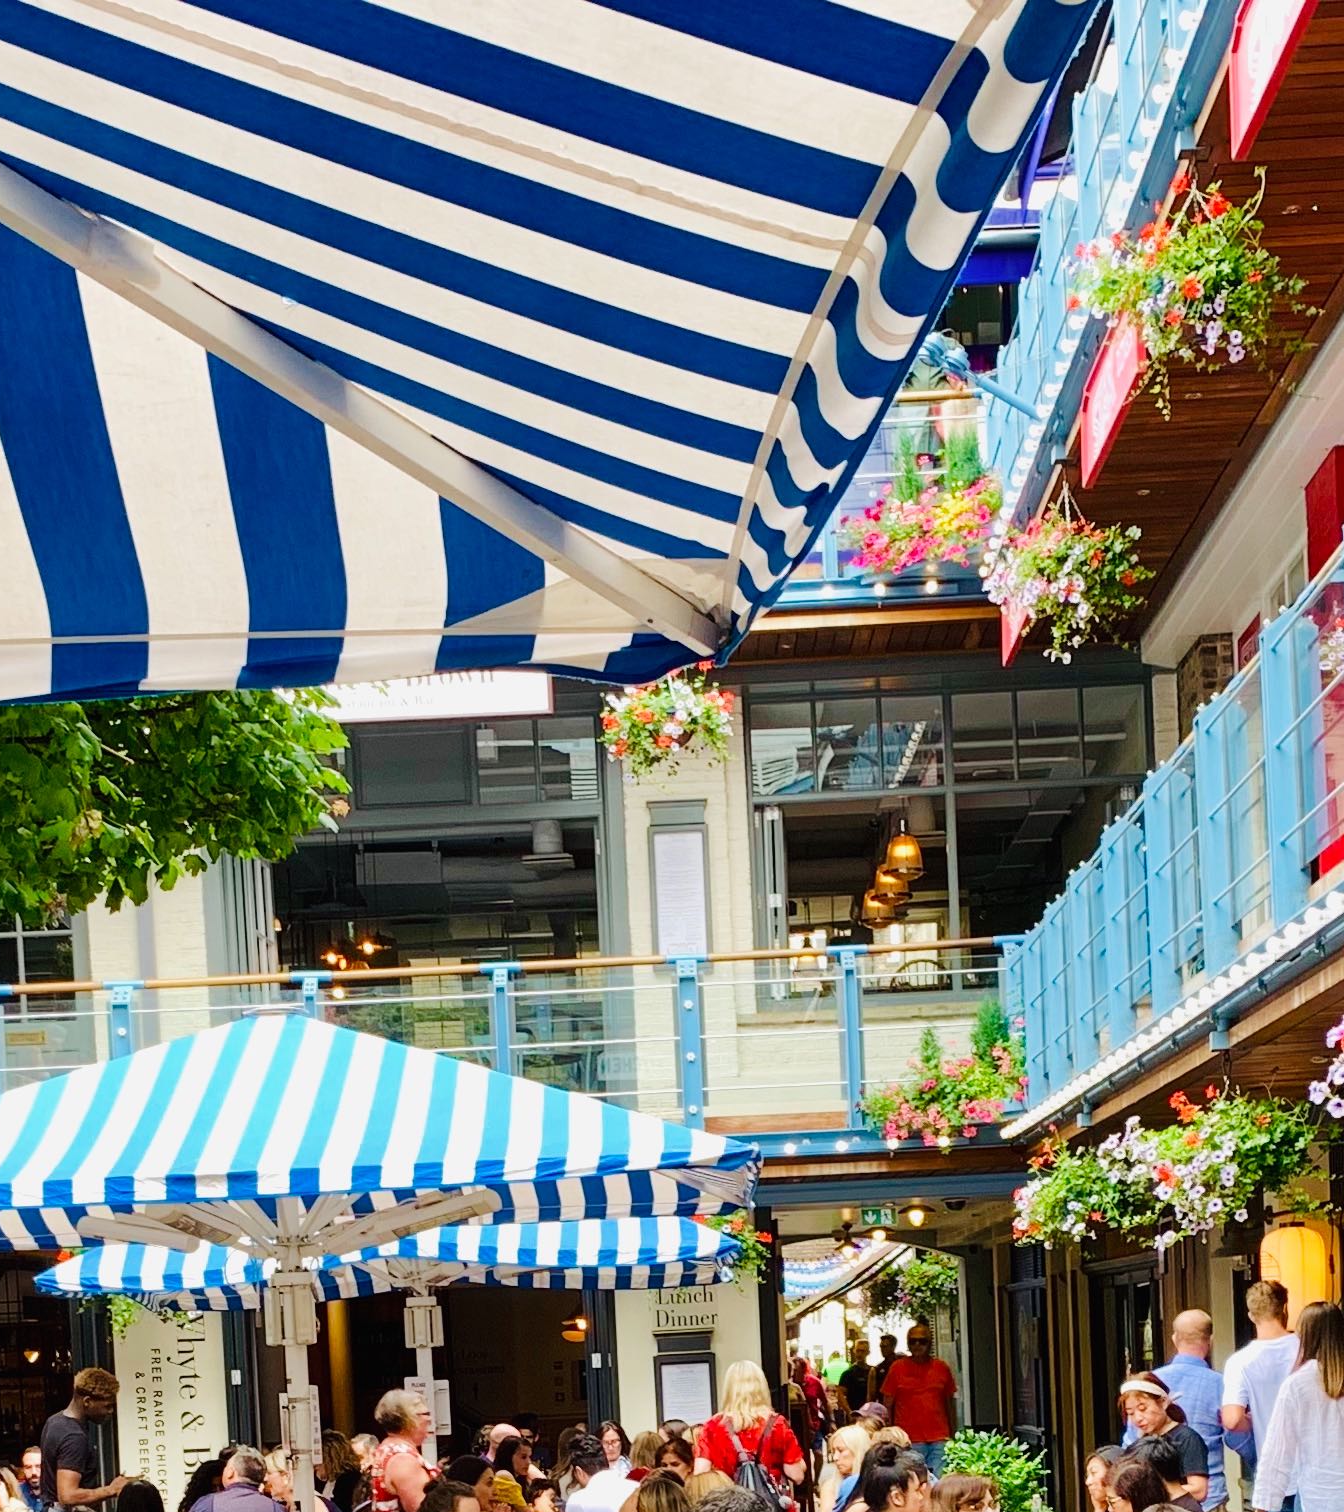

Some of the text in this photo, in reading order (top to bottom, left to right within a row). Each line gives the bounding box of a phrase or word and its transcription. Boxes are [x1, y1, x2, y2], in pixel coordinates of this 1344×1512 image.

[656, 1285, 713, 1305] Lunch
[656, 1309, 718, 1328] Dinner
[134, 1371, 146, 1380] &
[150, 1348, 163, 1383] FREE
[135, 1386, 148, 1431] CRAFT
[153, 1390, 166, 1437] RANGE
[179, 1411, 206, 1433] &
